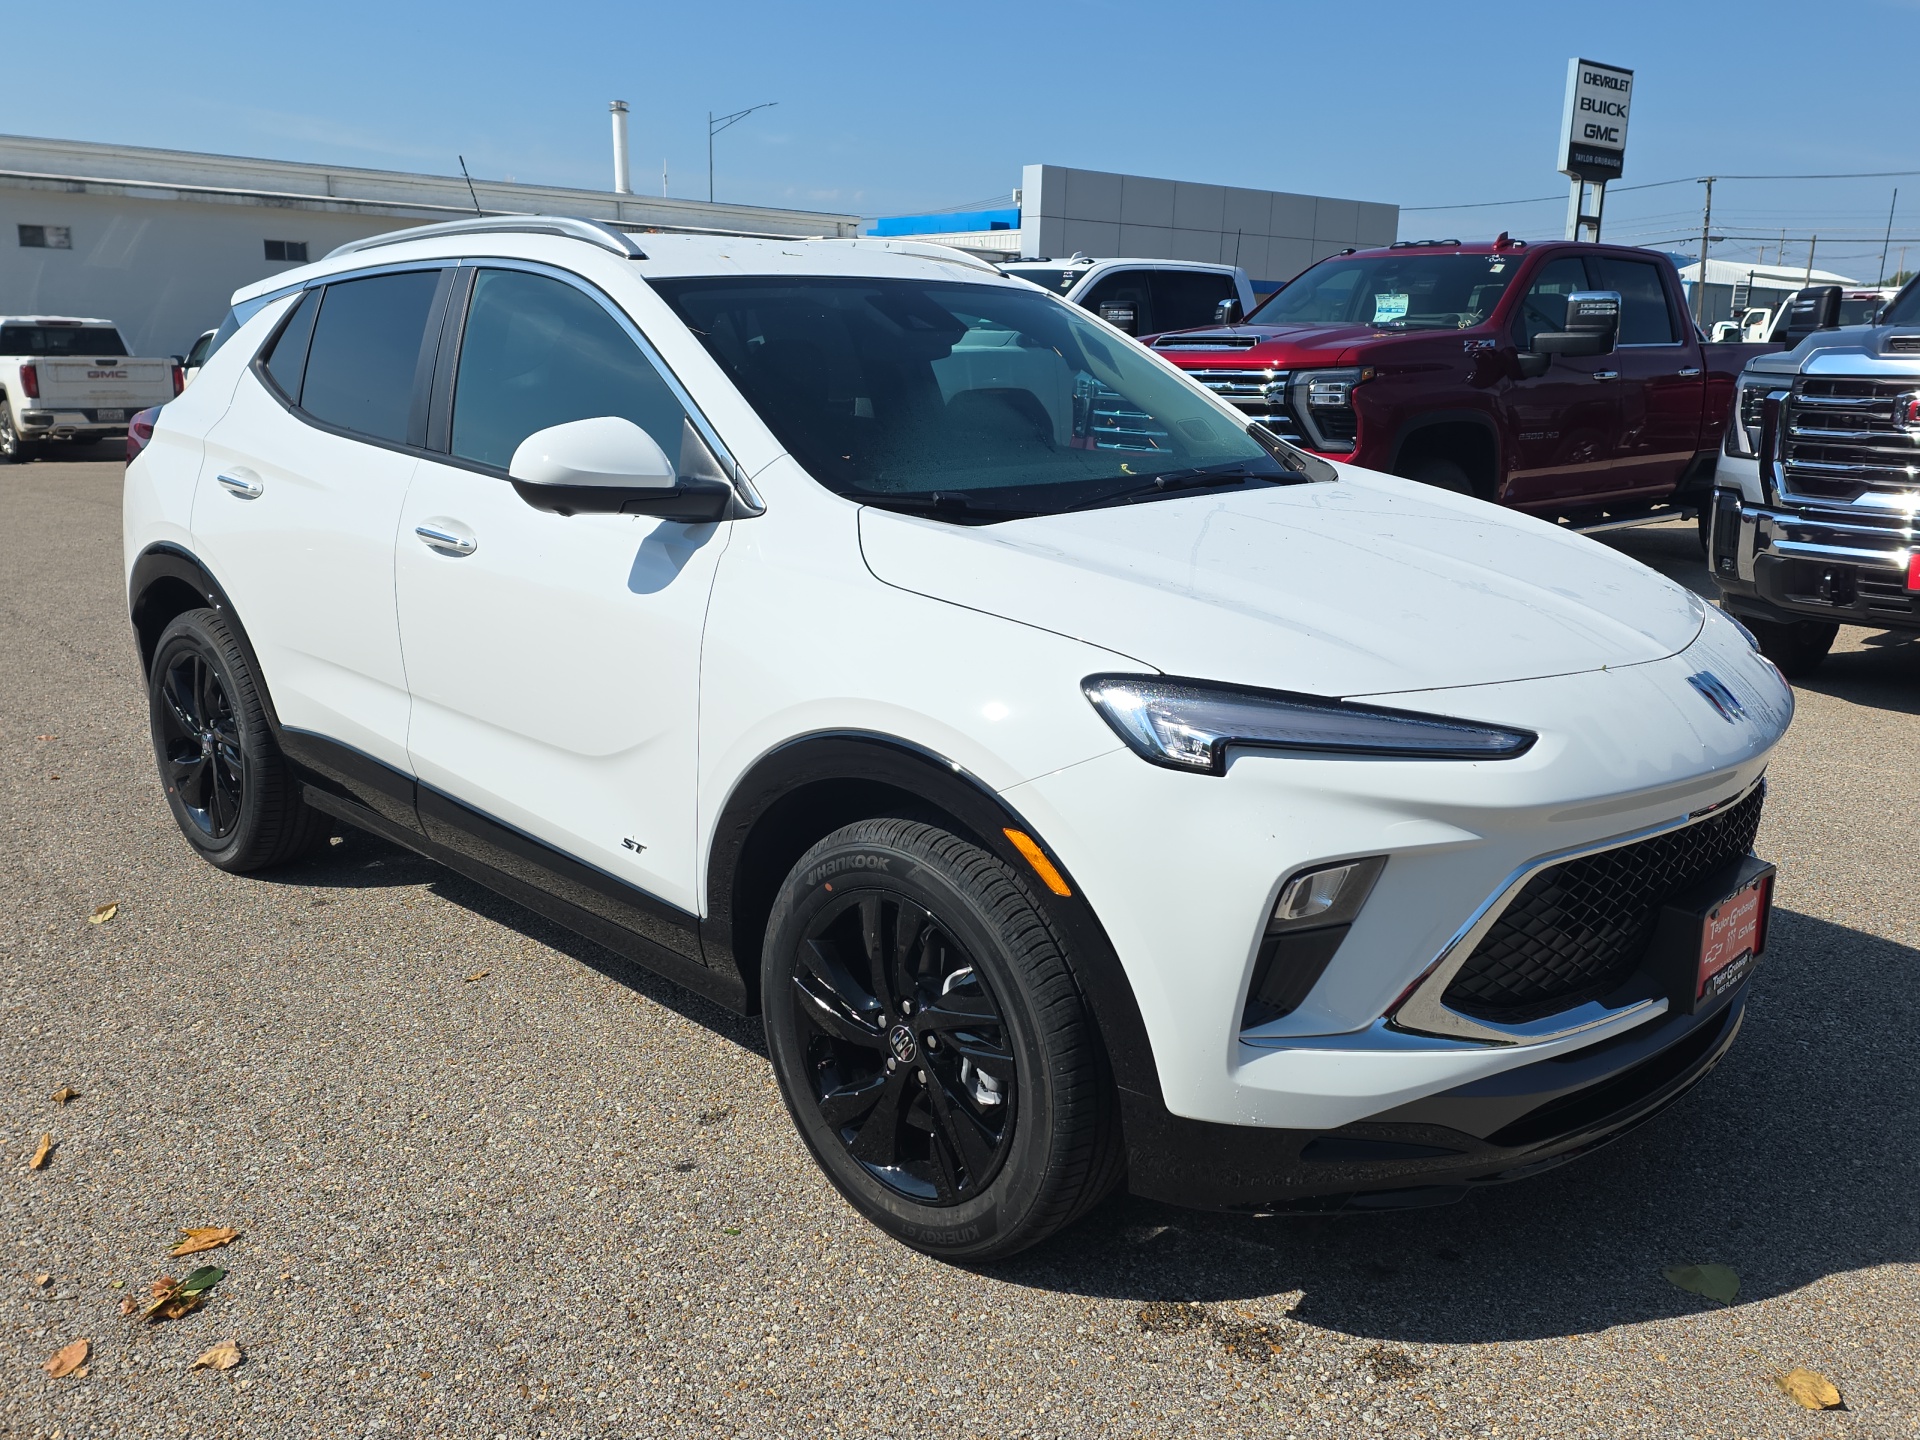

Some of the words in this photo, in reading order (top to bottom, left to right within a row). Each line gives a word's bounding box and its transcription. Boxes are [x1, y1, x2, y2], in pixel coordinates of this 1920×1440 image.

[1583, 72, 1630, 92] CHEVROLET
[1580, 97, 1627, 118] BUICK
[1583, 123, 1619, 143] GMC
[87, 370, 128, 379] GMC
[621, 838, 647, 854] ST
[1710, 917, 1730, 940] Taylor
[1738, 919, 1756, 939] GMC
[1712, 971, 1727, 990] Taylor
